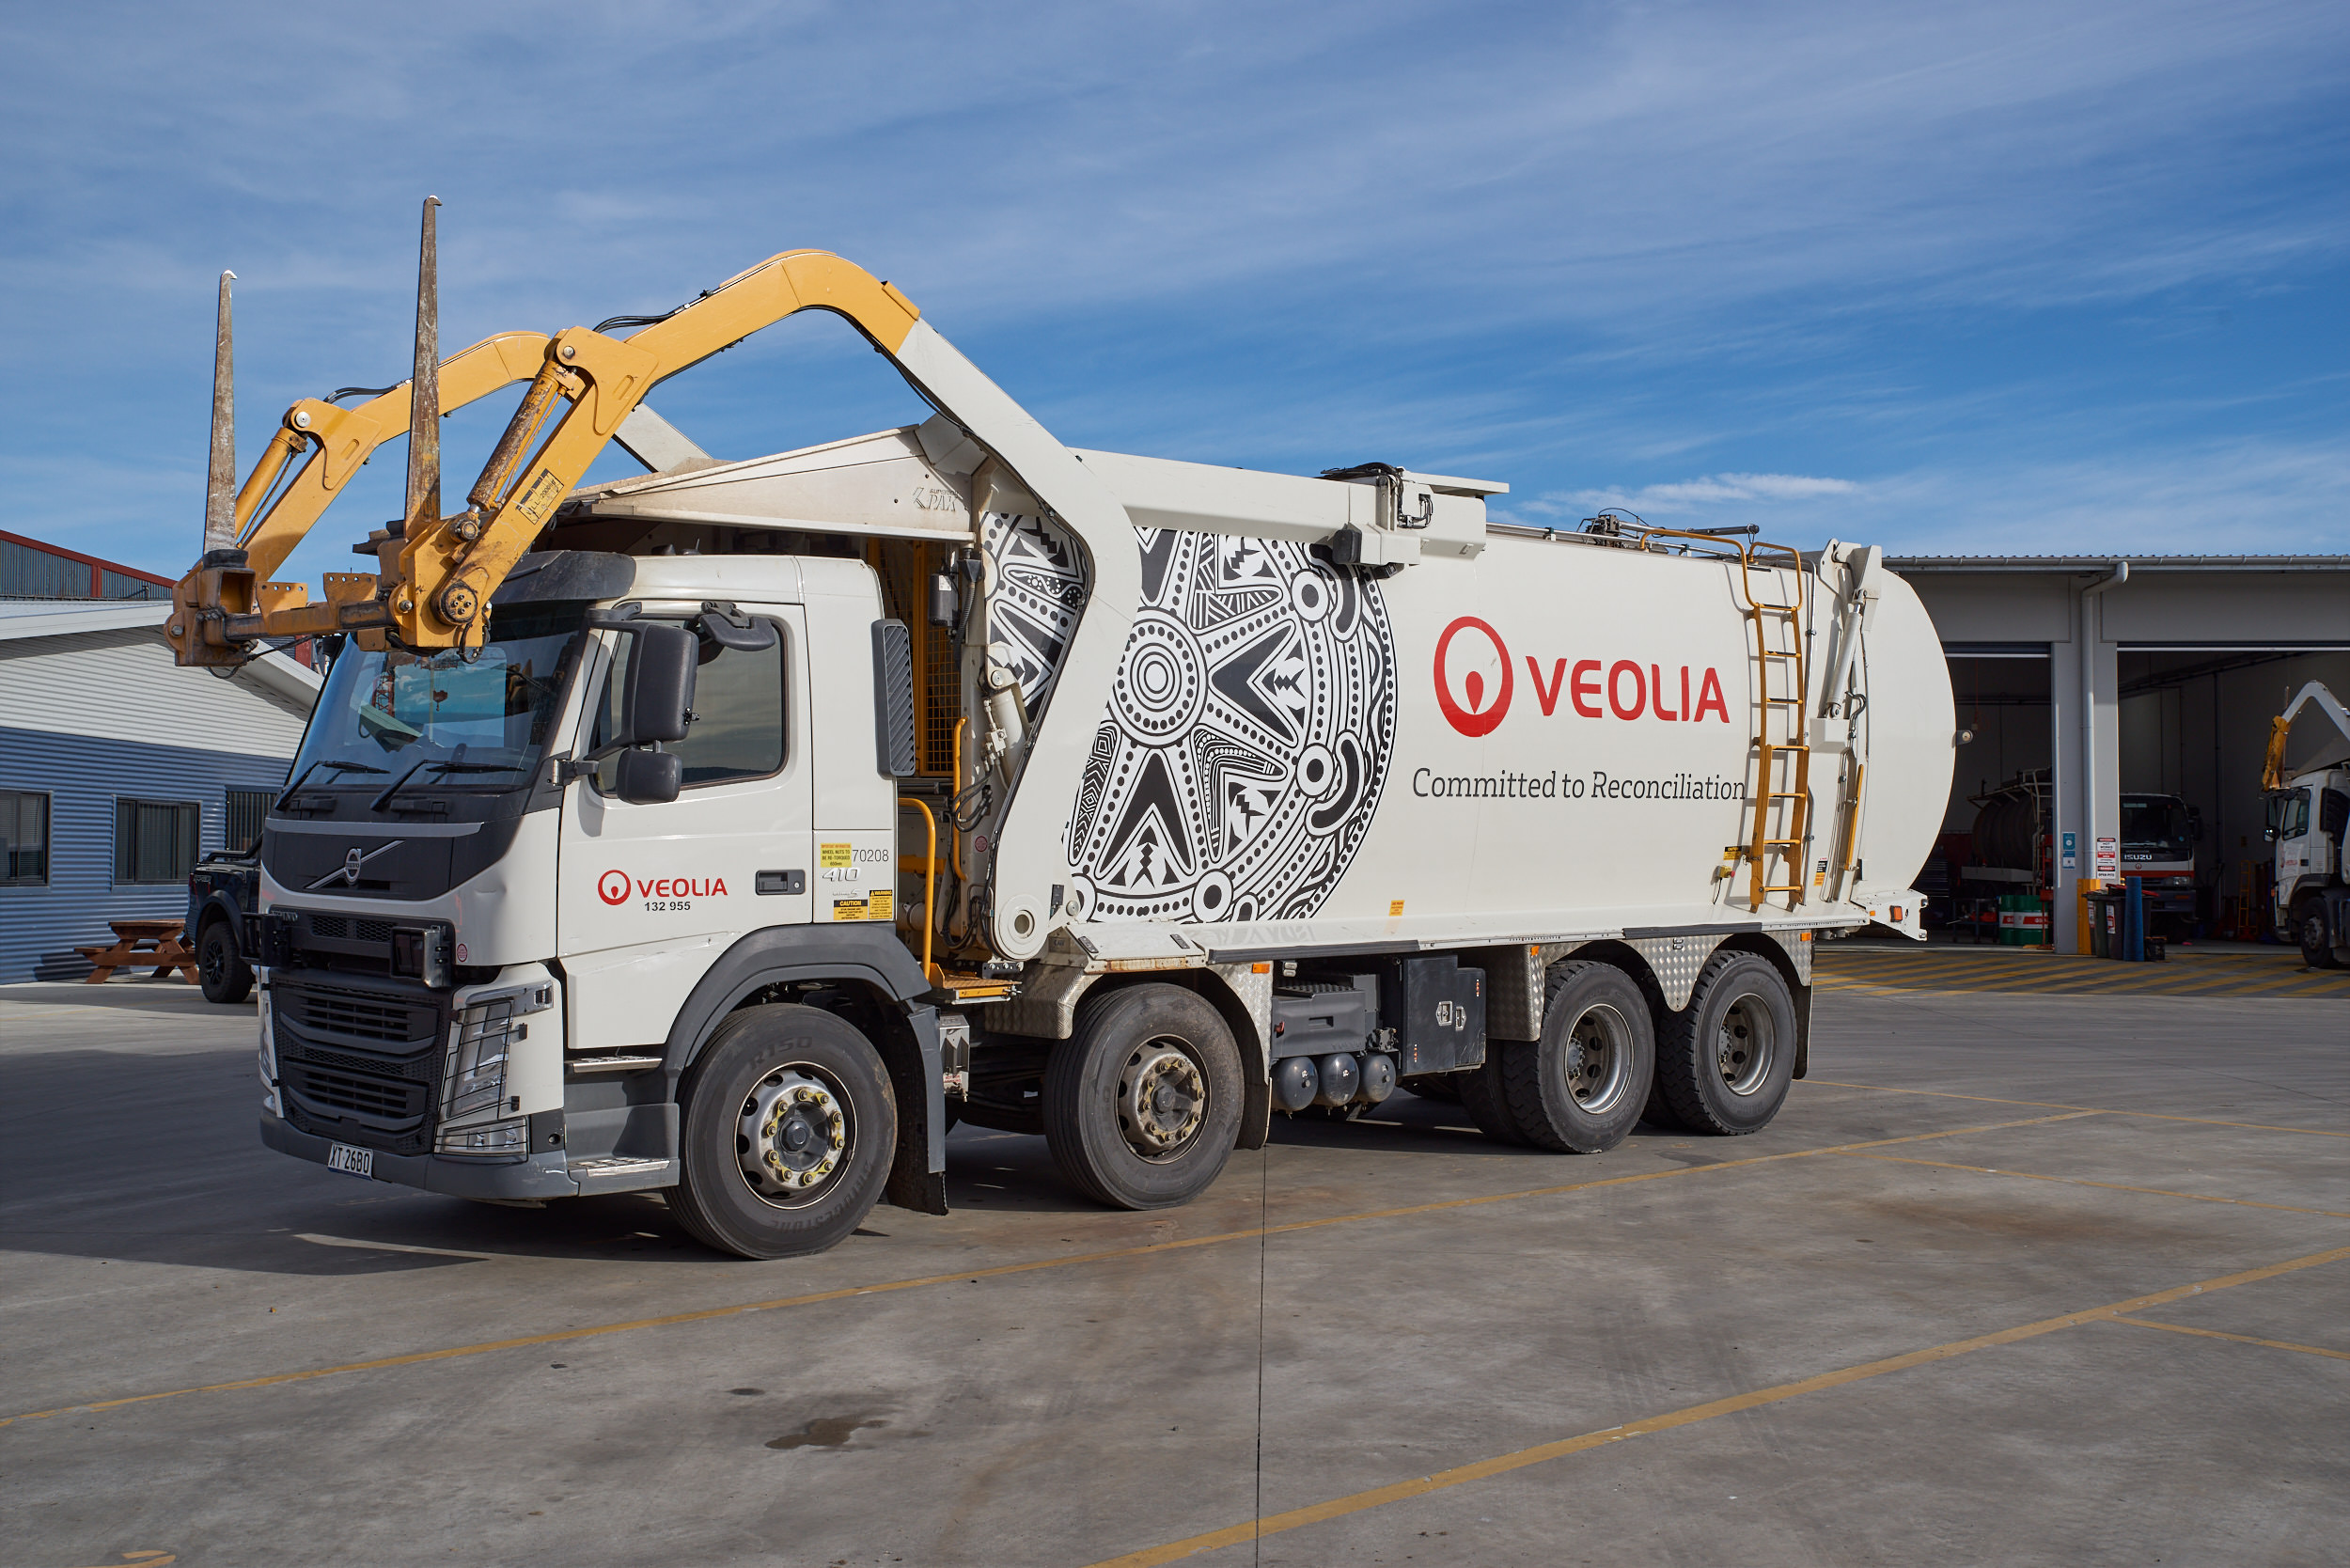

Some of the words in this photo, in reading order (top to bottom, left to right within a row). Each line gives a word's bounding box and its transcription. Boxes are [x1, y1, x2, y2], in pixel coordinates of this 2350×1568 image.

[1526, 655, 1731, 724] VEOLIA
[1413, 768, 1556, 799] Committed
[1561, 774, 1585, 799] to
[1590, 771, 1746, 800] Reconciliation
[852, 849, 889, 863] 70208
[822, 868, 861, 882] 410
[636, 877, 728, 899] VEOLIA
[644, 902, 666, 912] 132
[669, 901, 691, 911] 955
